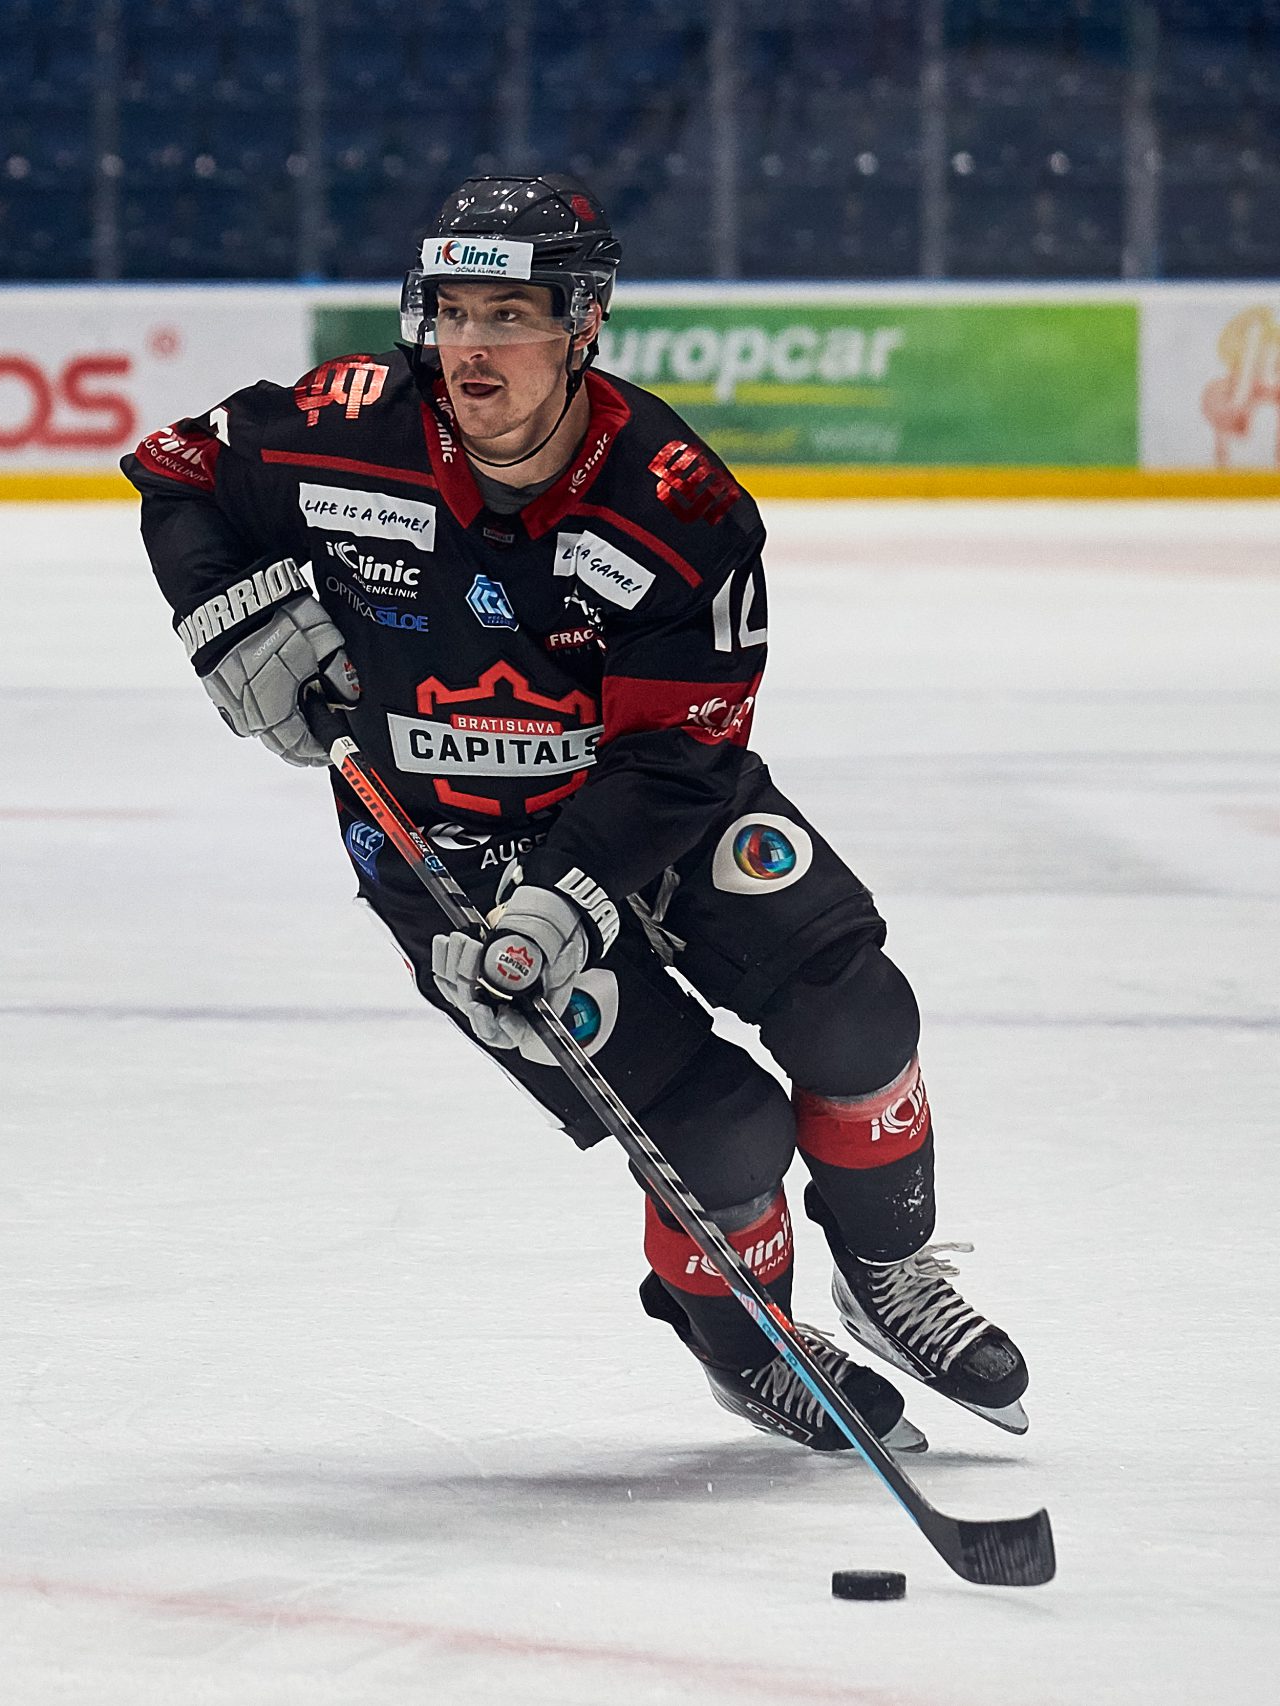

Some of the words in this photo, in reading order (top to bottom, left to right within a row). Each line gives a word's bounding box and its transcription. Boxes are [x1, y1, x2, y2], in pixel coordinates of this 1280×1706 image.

[435, 240, 509, 267] iClinic
[598, 325, 906, 403] uropcar
[305, 500, 338, 515] LIFE
[343, 504, 358, 519] IS
[361, 508, 372, 521] A
[378, 510, 430, 533] GAME!
[326, 541, 421, 586] iClinic
[590, 557, 642, 593] GAME!
[177, 557, 309, 662] WARRIOR
[458, 716, 555, 734] BRATISLAVA
[409, 728, 602, 765] CAPITALS
